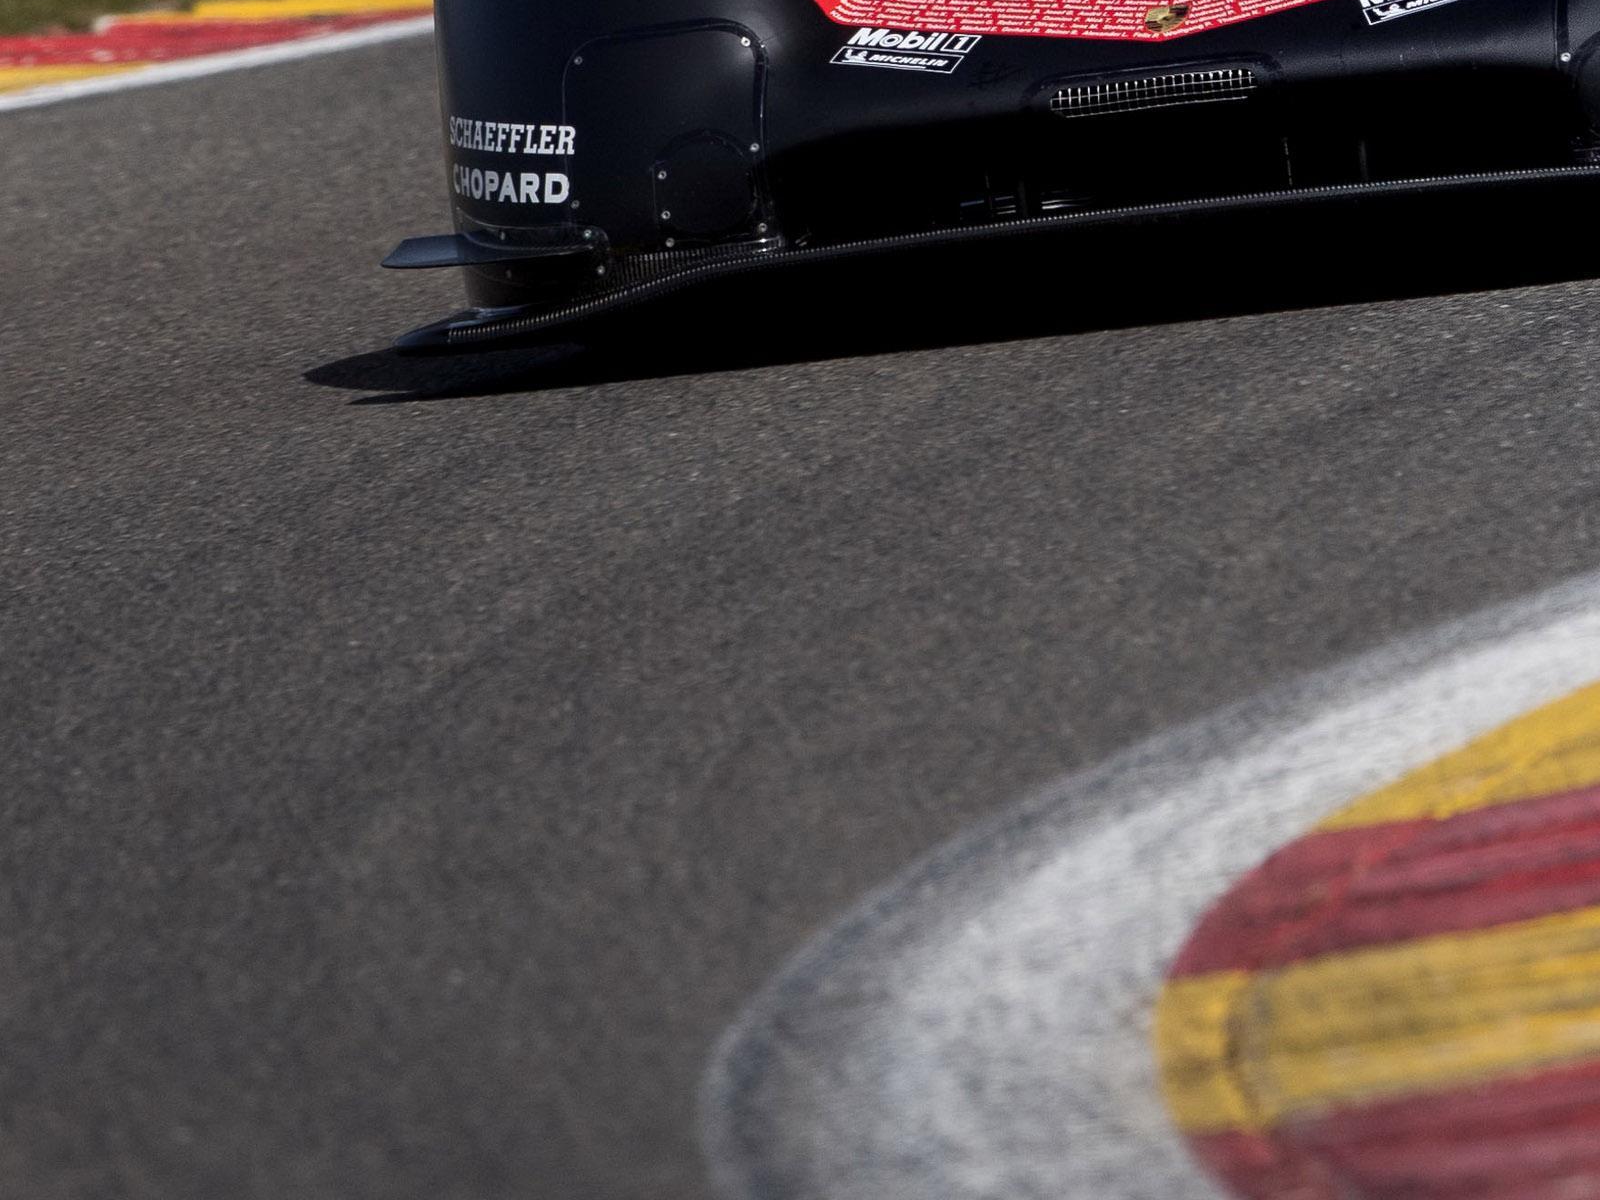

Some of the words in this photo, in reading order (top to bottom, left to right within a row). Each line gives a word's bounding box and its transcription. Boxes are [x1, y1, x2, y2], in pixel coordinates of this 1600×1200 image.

[847, 27, 949, 51] Mobil
[868, 53, 949, 67] MICHELIN
[450, 116, 576, 155] SCHAEFFLER
[453, 163, 571, 204] CHOPARD
